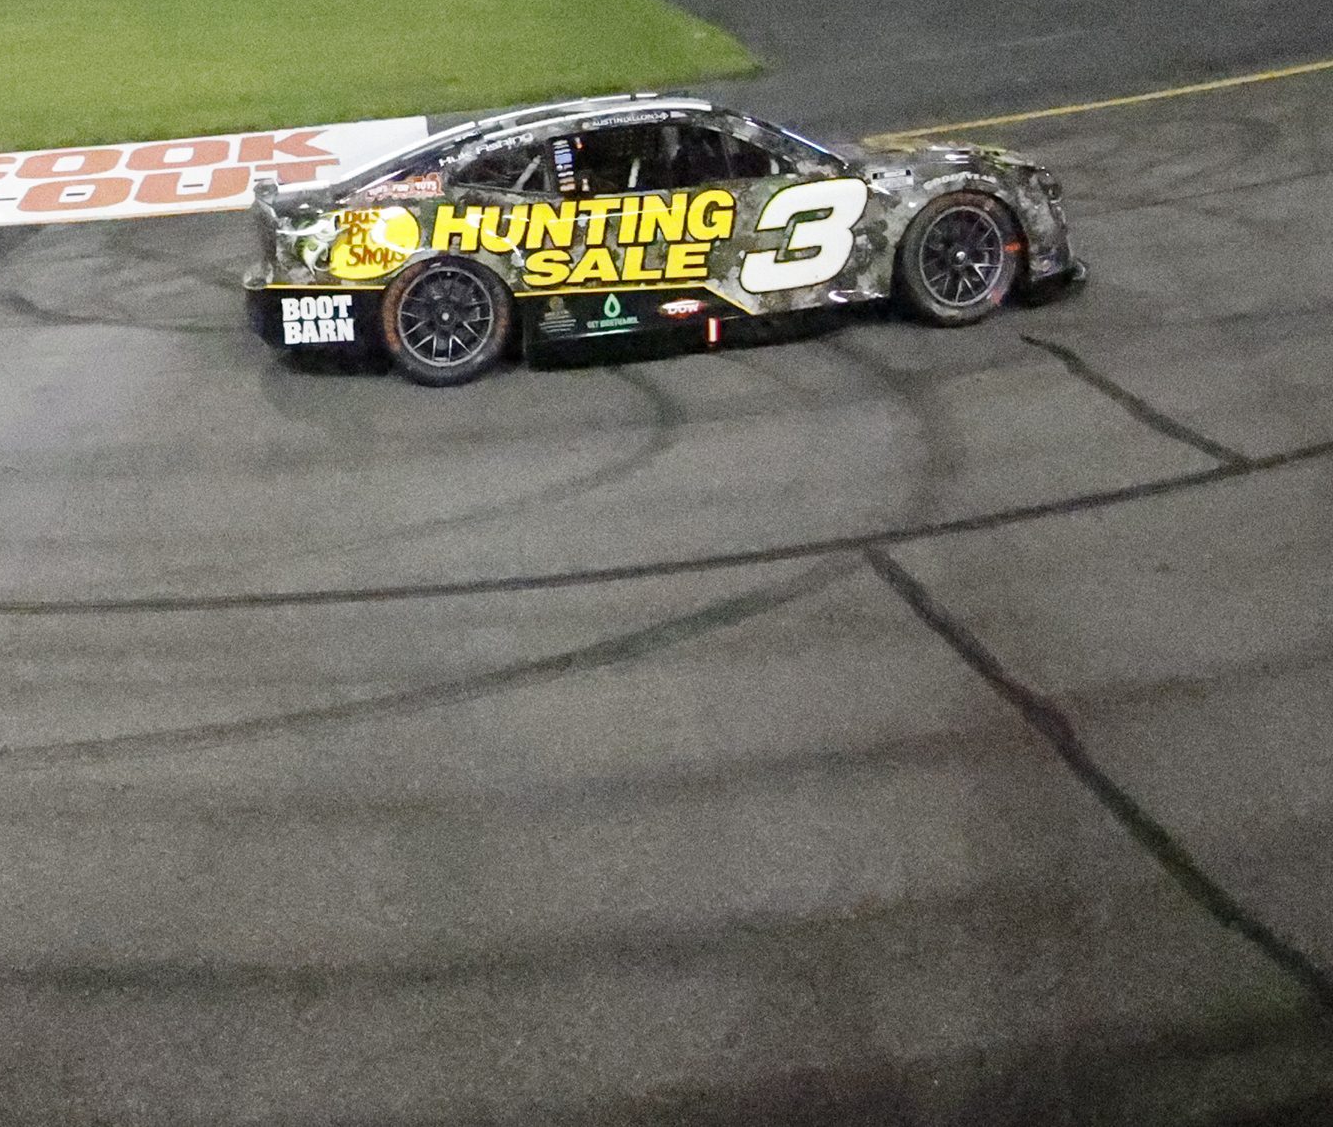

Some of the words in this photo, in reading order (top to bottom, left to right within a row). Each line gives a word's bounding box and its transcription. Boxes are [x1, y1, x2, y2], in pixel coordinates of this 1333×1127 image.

[14, 158, 340, 213] OUT
[431, 188, 737, 254] HUNTING
[739, 177, 869, 293] 3
[522, 241, 714, 288] SALE
[281, 295, 353, 322] BOOT
[283, 319, 354, 345] BARN
